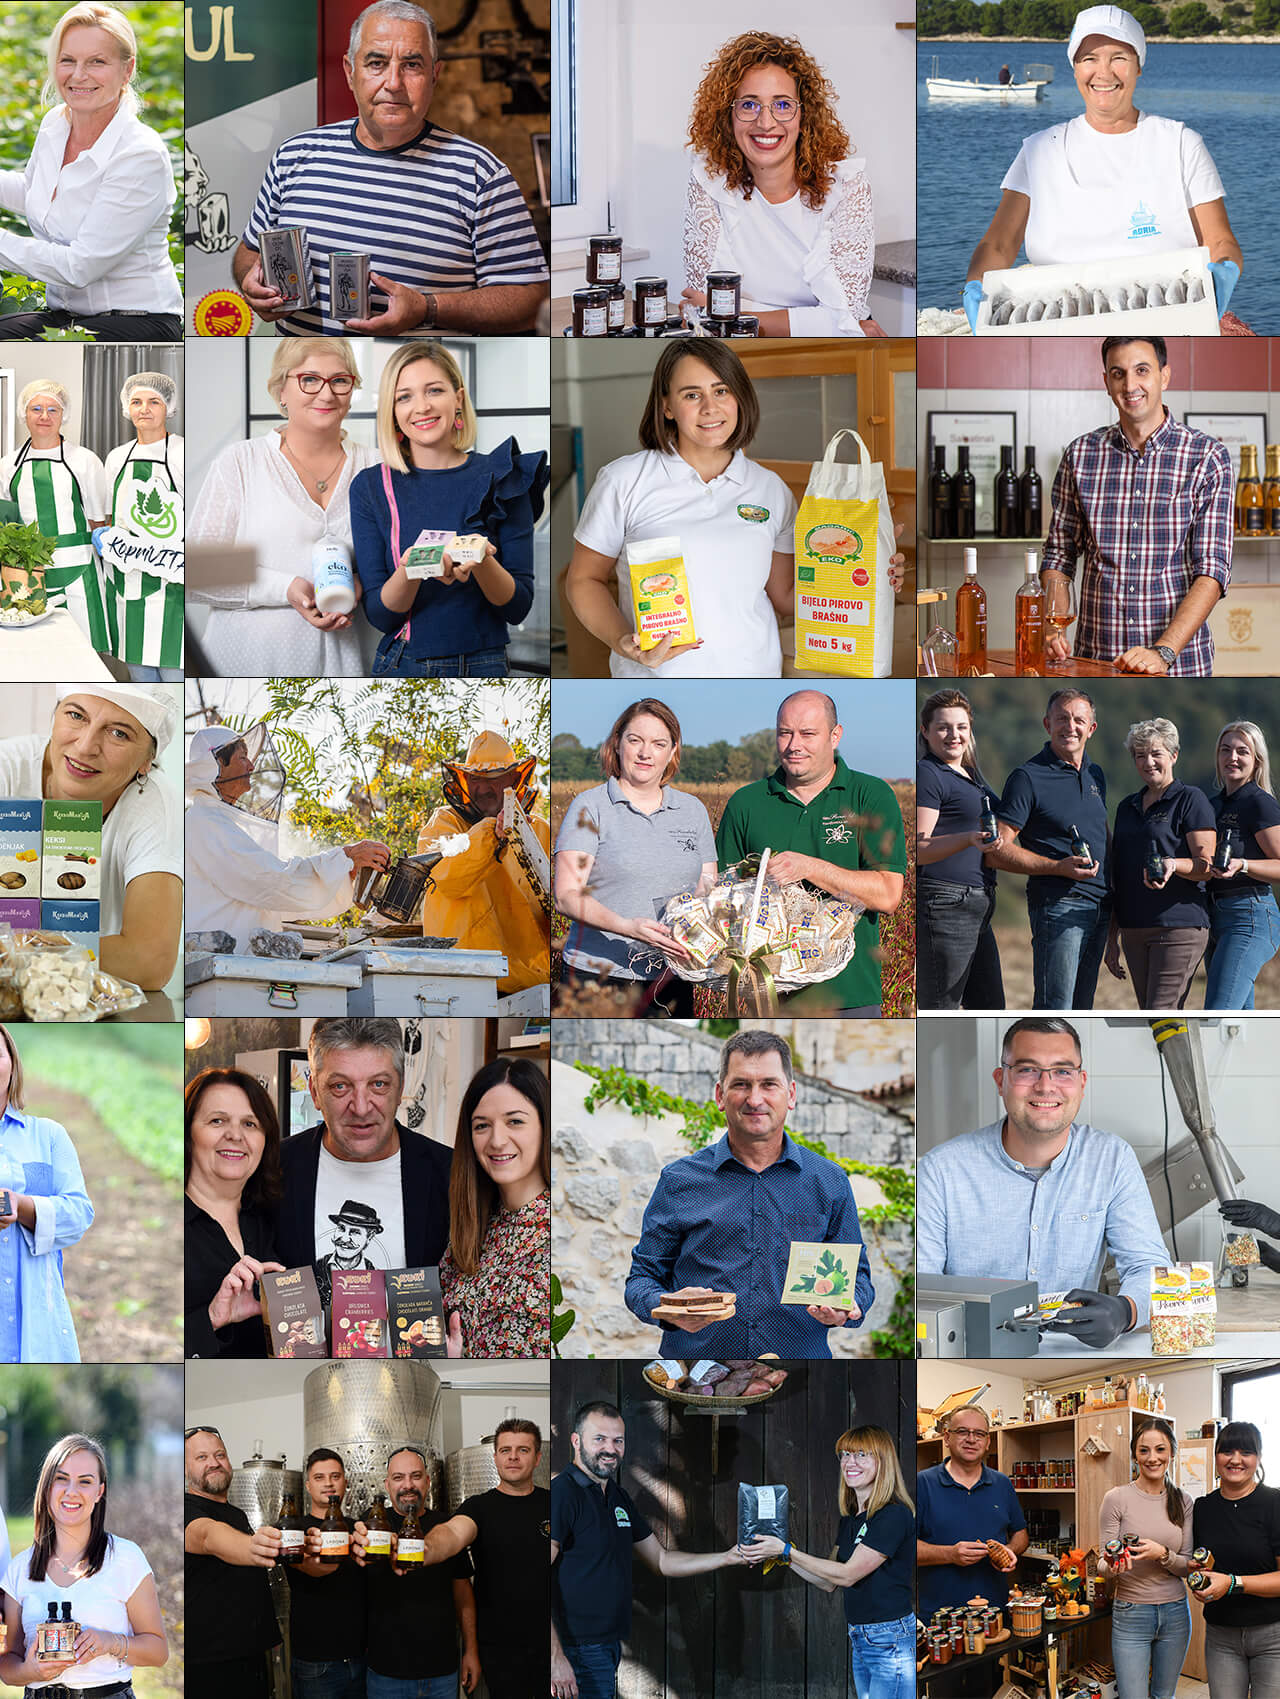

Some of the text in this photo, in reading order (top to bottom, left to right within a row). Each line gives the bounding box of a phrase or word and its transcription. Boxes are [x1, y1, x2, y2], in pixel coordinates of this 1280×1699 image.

[802, 595, 863, 610] BIJELO PIROVO
[645, 609, 682, 621] INTEGRALNO
[812, 611, 849, 623] BRAŠNO
[642, 621, 664, 630] PIROVO
[808, 637, 852, 652] Neto 5 kg
